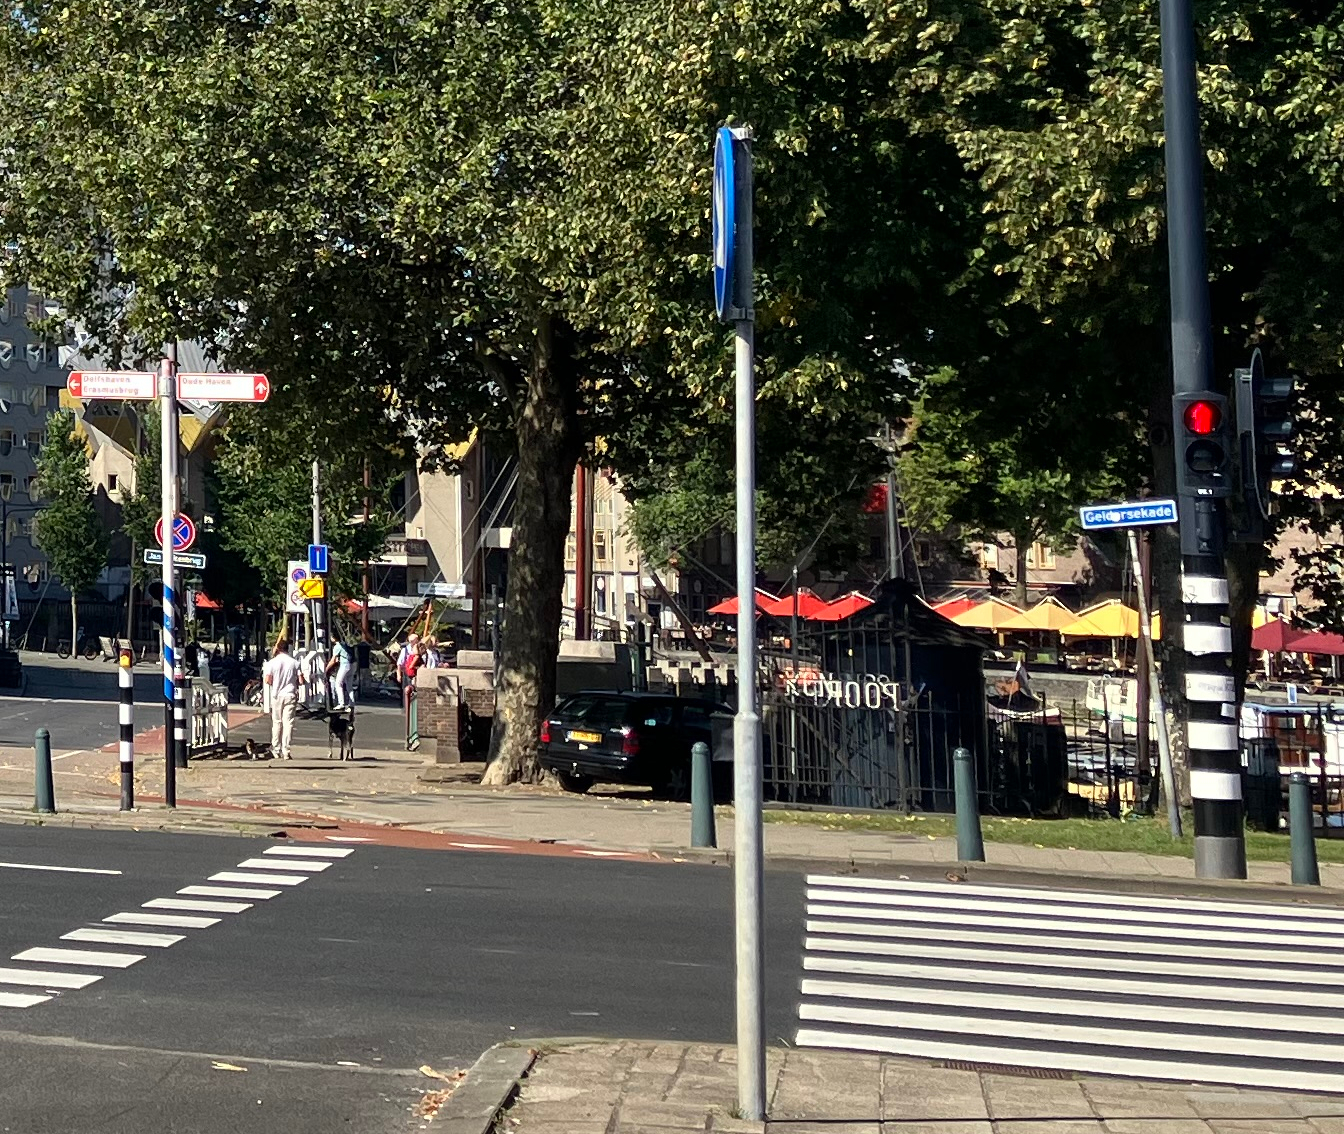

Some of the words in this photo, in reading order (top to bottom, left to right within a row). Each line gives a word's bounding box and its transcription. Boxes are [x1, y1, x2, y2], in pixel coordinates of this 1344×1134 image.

[83, 375, 131, 384] Delfshaven
[182, 377, 203, 385] Oude
[205, 377, 232, 385] Haven
[83, 385, 139, 395] Erasmusbrug
[1085, 506, 1172, 523] Geldrsekade
